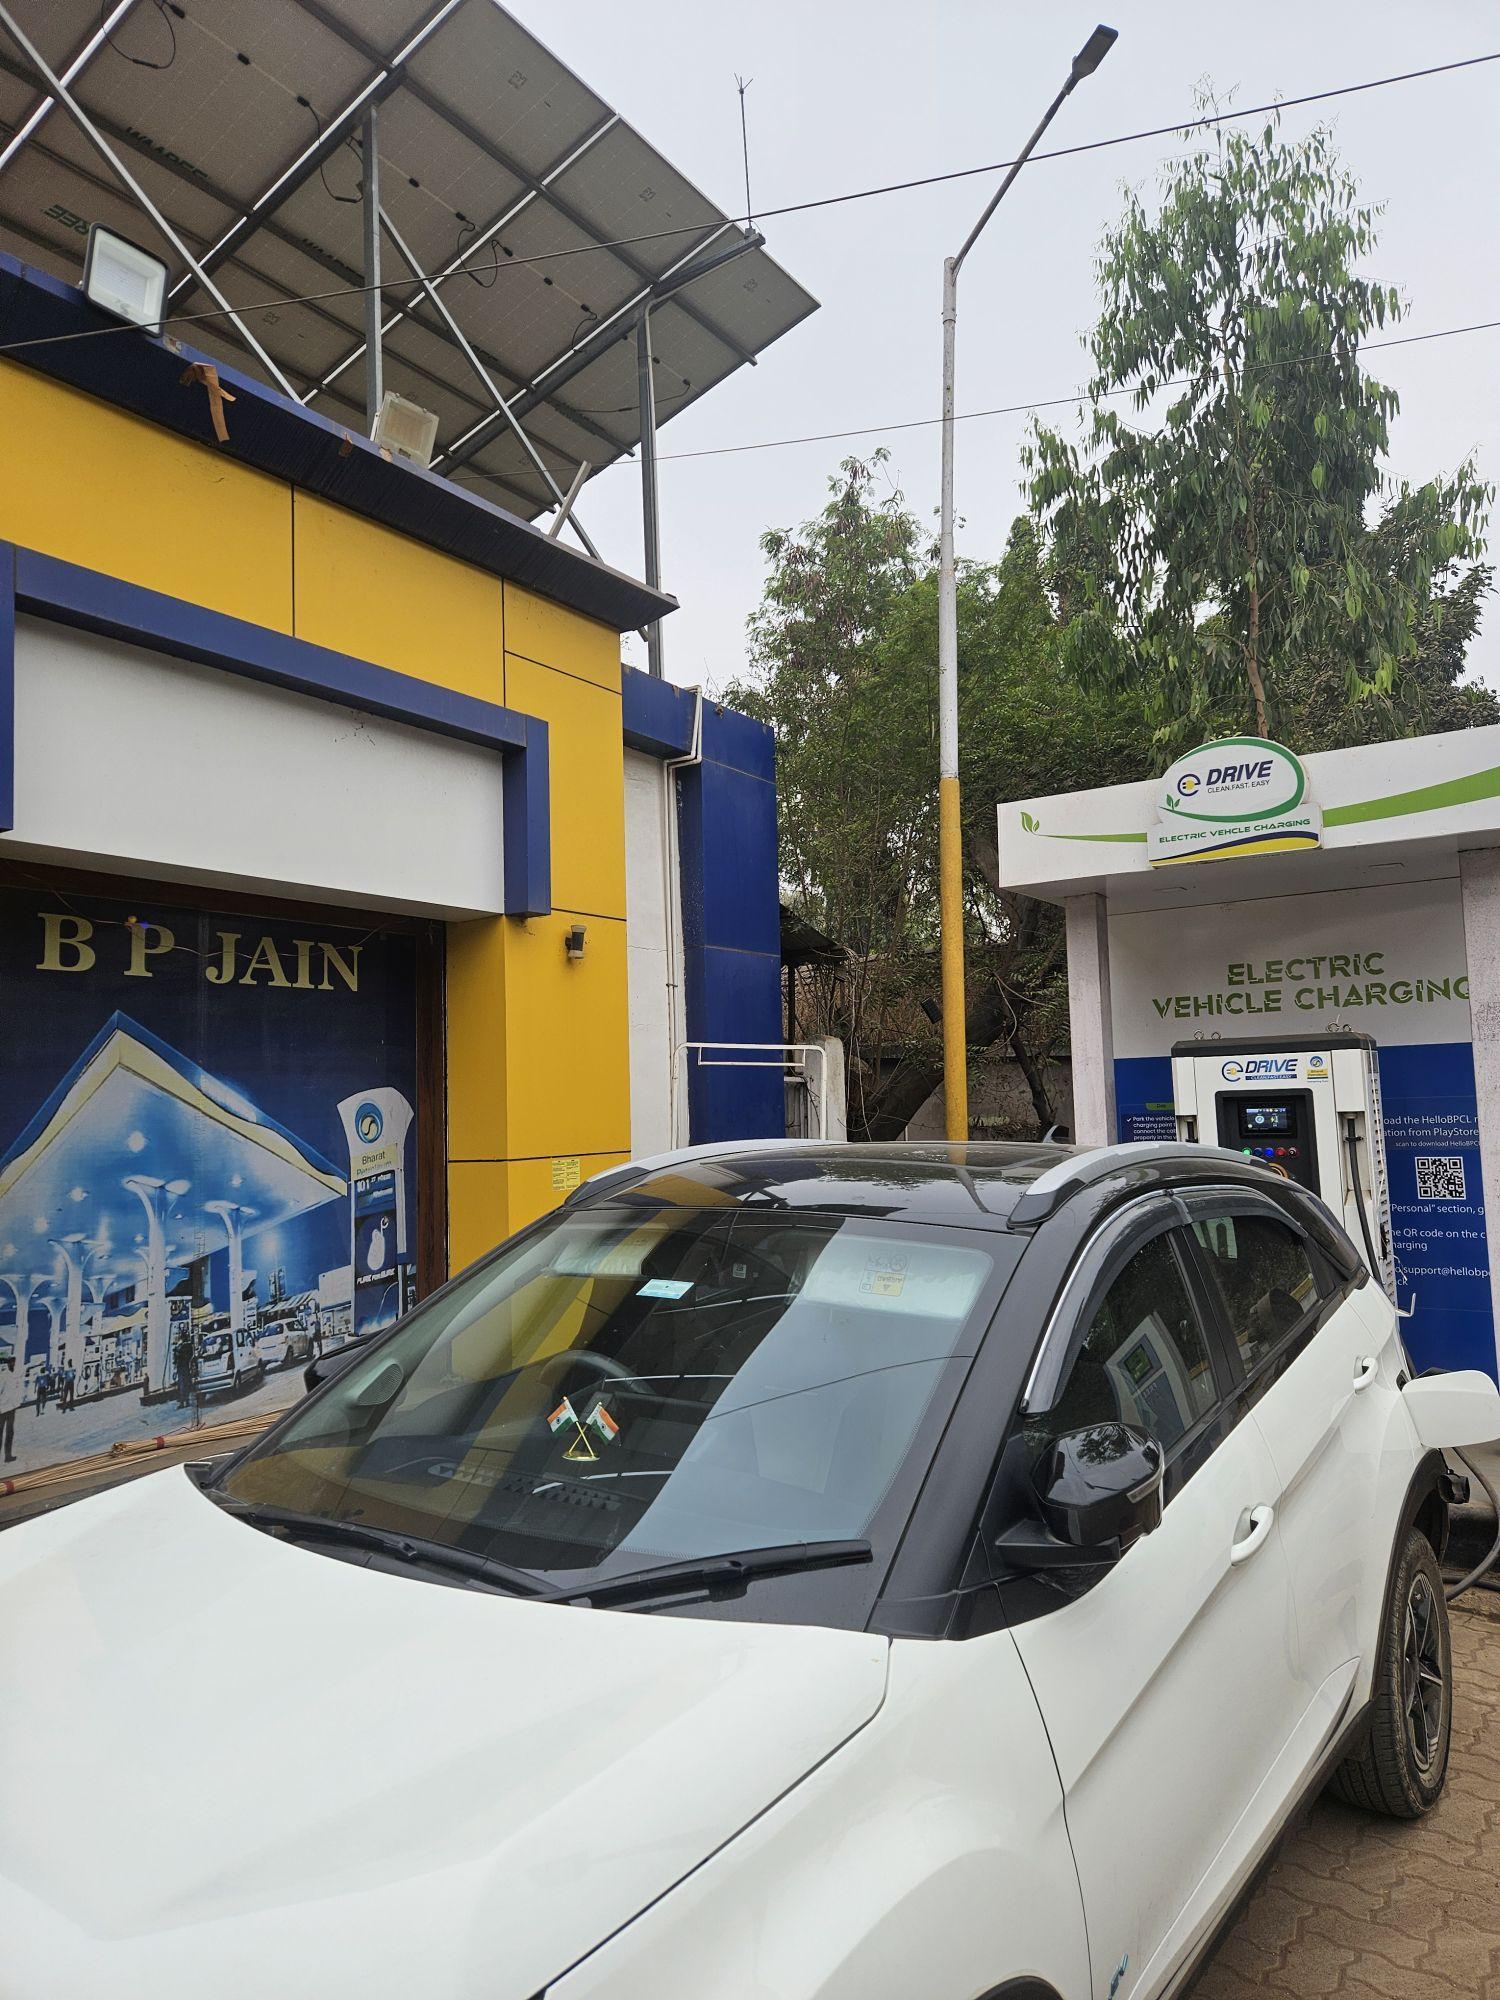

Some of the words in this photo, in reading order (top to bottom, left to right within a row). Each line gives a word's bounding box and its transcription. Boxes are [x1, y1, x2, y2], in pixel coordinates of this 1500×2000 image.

[1206, 759, 1273, 786] DRIVE
[1251, 779, 1270, 789] EASY
[1159, 831, 1207, 844] ELECTRIC
[1209, 826, 1251, 837] VEHCLE
[1253, 818, 1311, 832] CHARGING
[35, 913, 96, 973] B
[123, 922, 175, 977] P
[205, 931, 364, 992] JAIN
[1227, 952, 1385, 986] ELECTRIC
[1151, 989, 1282, 1019] VEHICLE
[1245, 1058, 1298, 1074] DRIVE
[1403, 1116, 1420, 1124] the
[1421, 1114, 1472, 1124] HelloBPCL
[1408, 1127, 1431, 1136] from
[361, 1150, 386, 1165] Bharat
[1437, 1204, 1476, 1214] section,
[1403, 1228, 1418, 1237] QR
[1419, 1228, 1444, 1237] code
[1445, 1230, 1459, 1238] on
[1461, 1229, 1478, 1239] the
